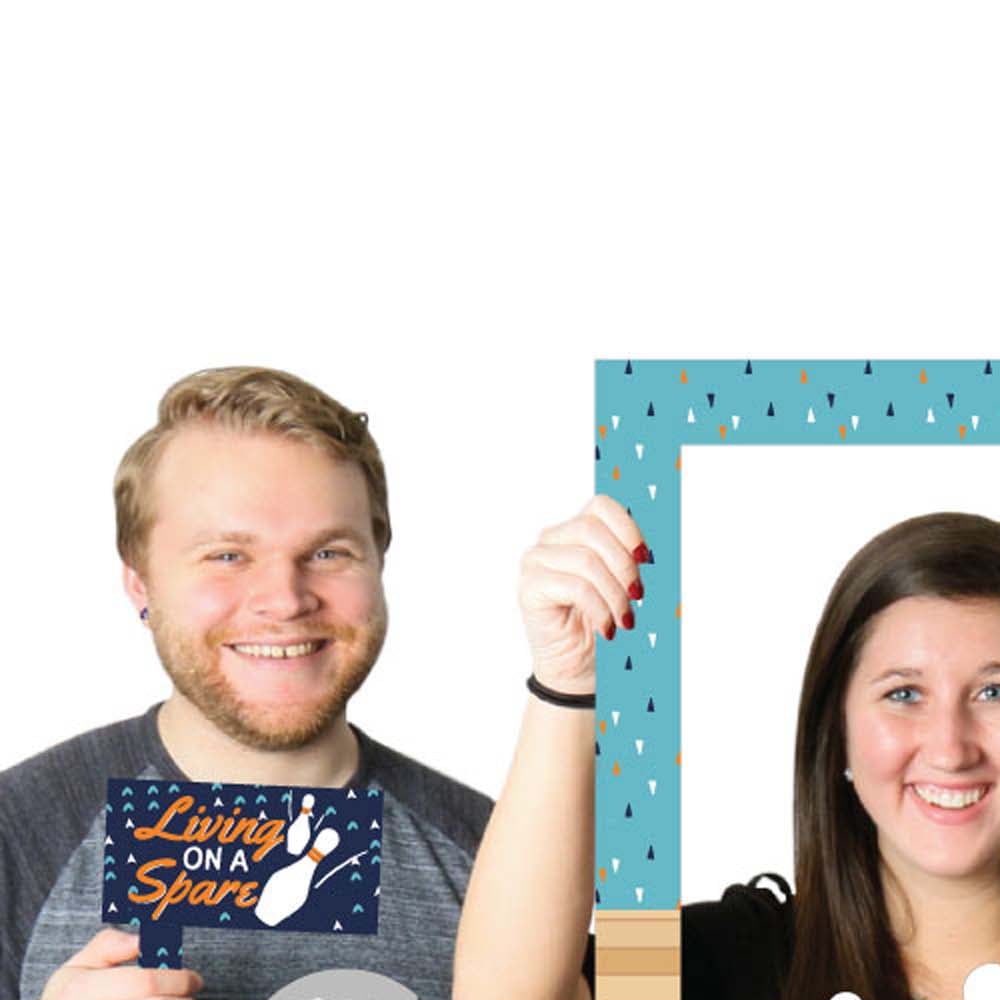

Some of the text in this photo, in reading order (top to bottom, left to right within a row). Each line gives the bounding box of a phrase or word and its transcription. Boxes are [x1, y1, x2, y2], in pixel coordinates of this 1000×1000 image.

[133, 796, 286, 862] Living
[183, 846, 249, 872] ON A
[127, 858, 259, 921] Spare
